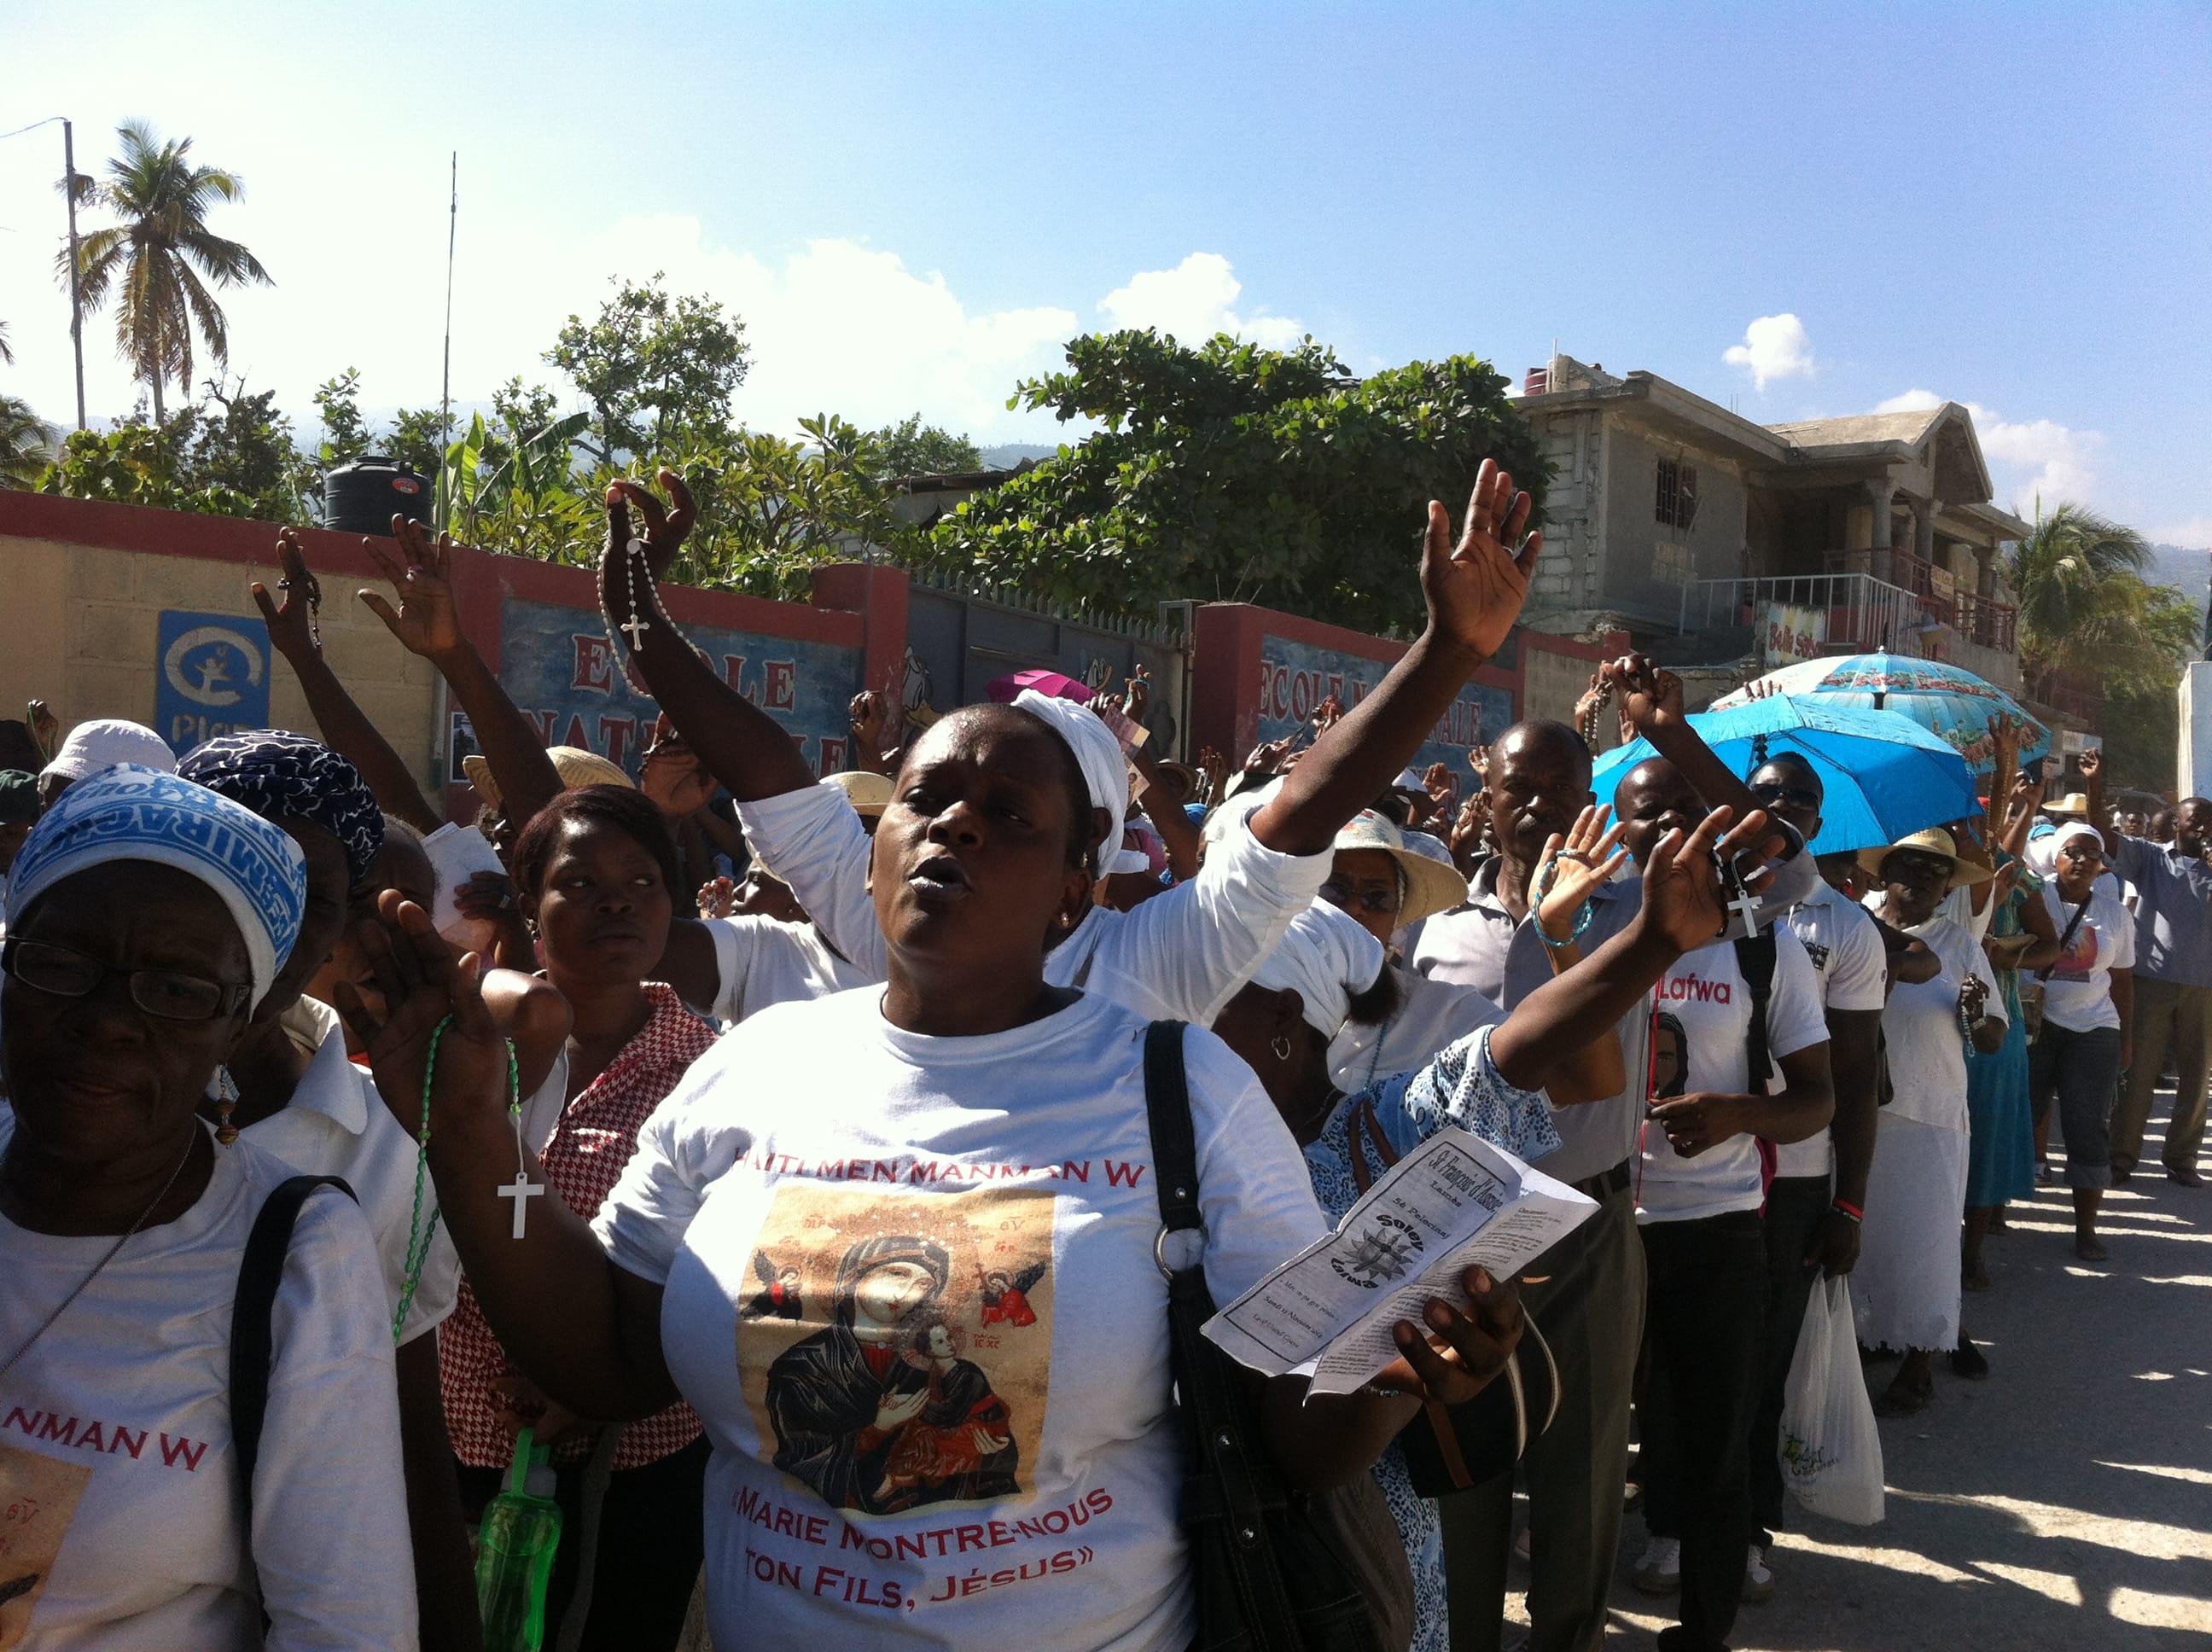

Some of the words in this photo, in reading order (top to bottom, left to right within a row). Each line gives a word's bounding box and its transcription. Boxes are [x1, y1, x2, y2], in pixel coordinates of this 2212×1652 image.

[571, 633, 797, 712] ELE
[816, 1158, 898, 1184] MEN
[1104, 1159, 1146, 1188] W
[1376, 1214, 1424, 1253] Soley
[160, 1432, 208, 1472] W
[841, 1487, 1114, 1561] MONTRE-NOUS
[745, 1546, 802, 1591] TON
[813, 1564, 916, 1614] FILS,
